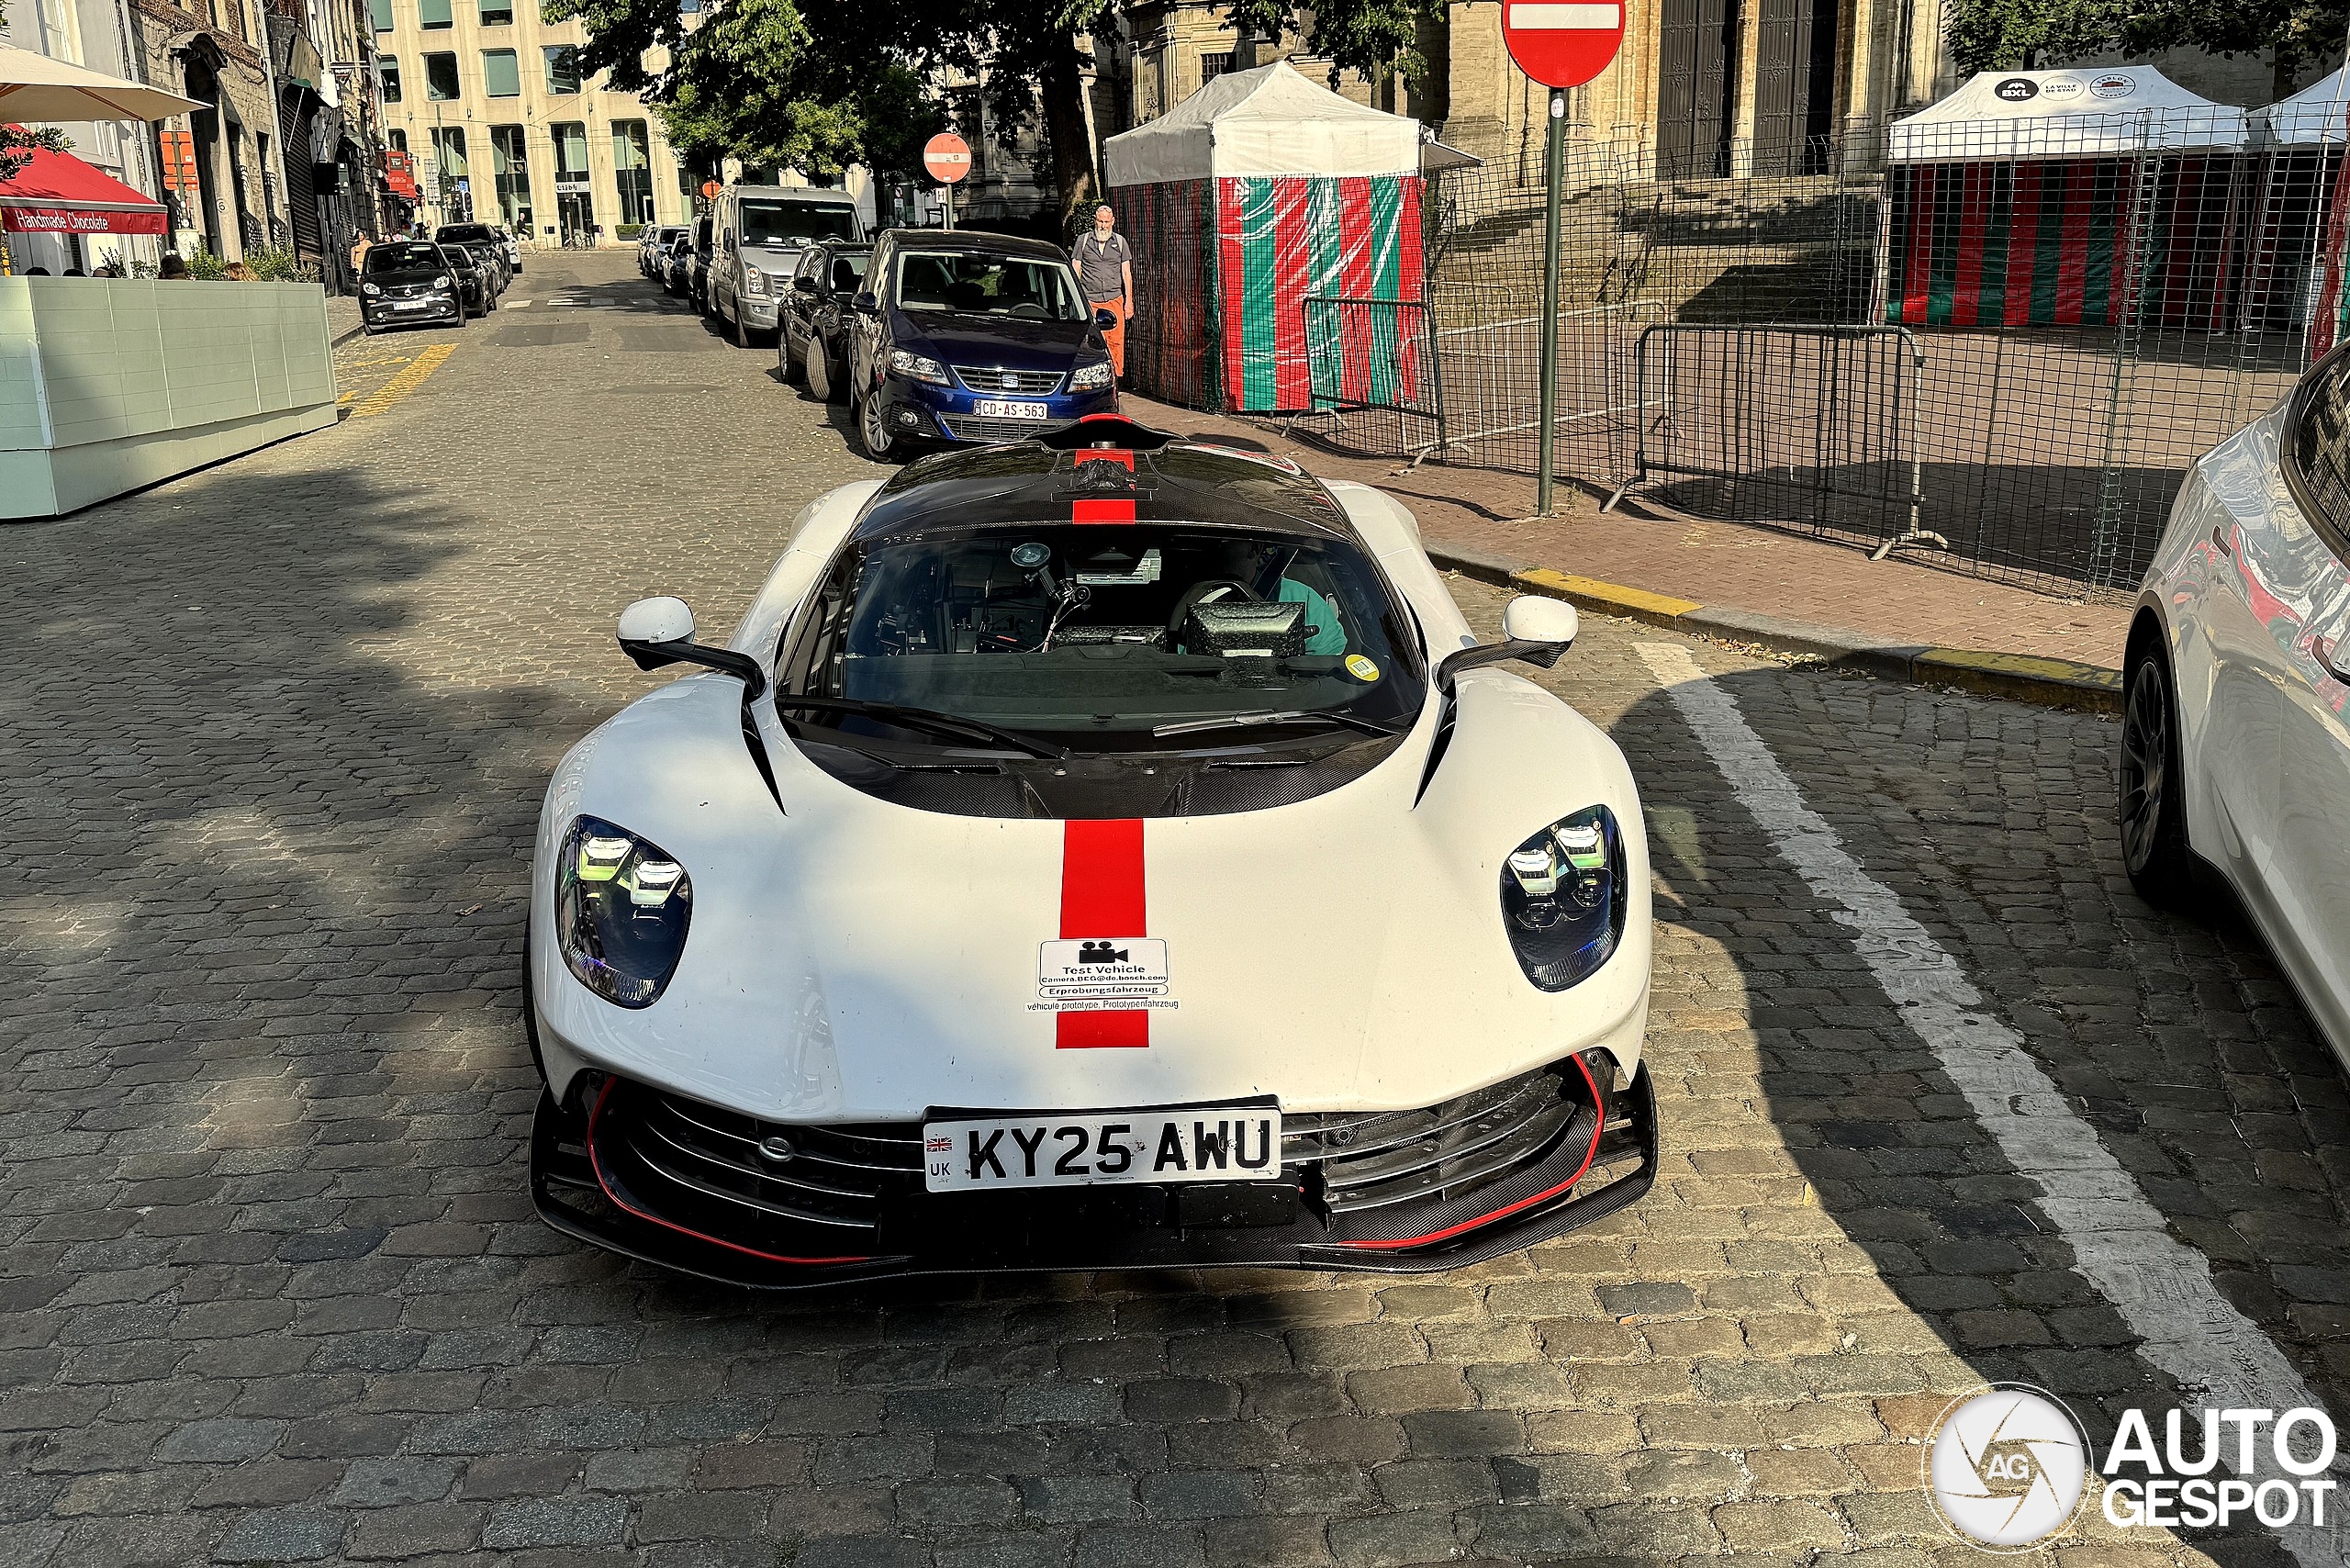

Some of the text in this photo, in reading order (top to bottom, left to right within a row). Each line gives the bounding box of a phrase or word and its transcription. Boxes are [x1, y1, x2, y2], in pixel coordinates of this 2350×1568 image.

[2001, 89, 2031, 97] BXL
[15, 209, 108, 230] Handmade Chocolate
[982, 402, 1045, 418] CD-AS-563
[1062, 965, 1146, 975] Test Vehicle
[1048, 986, 1158, 996] Erprobungsfahrzeug
[1026, 1002, 1059, 1011] véhicule
[1102, 999, 1179, 1011] Prototypenfahrzeug
[968, 1119, 1270, 1180] KY25 AWU
[930, 1162, 951, 1176] UK
